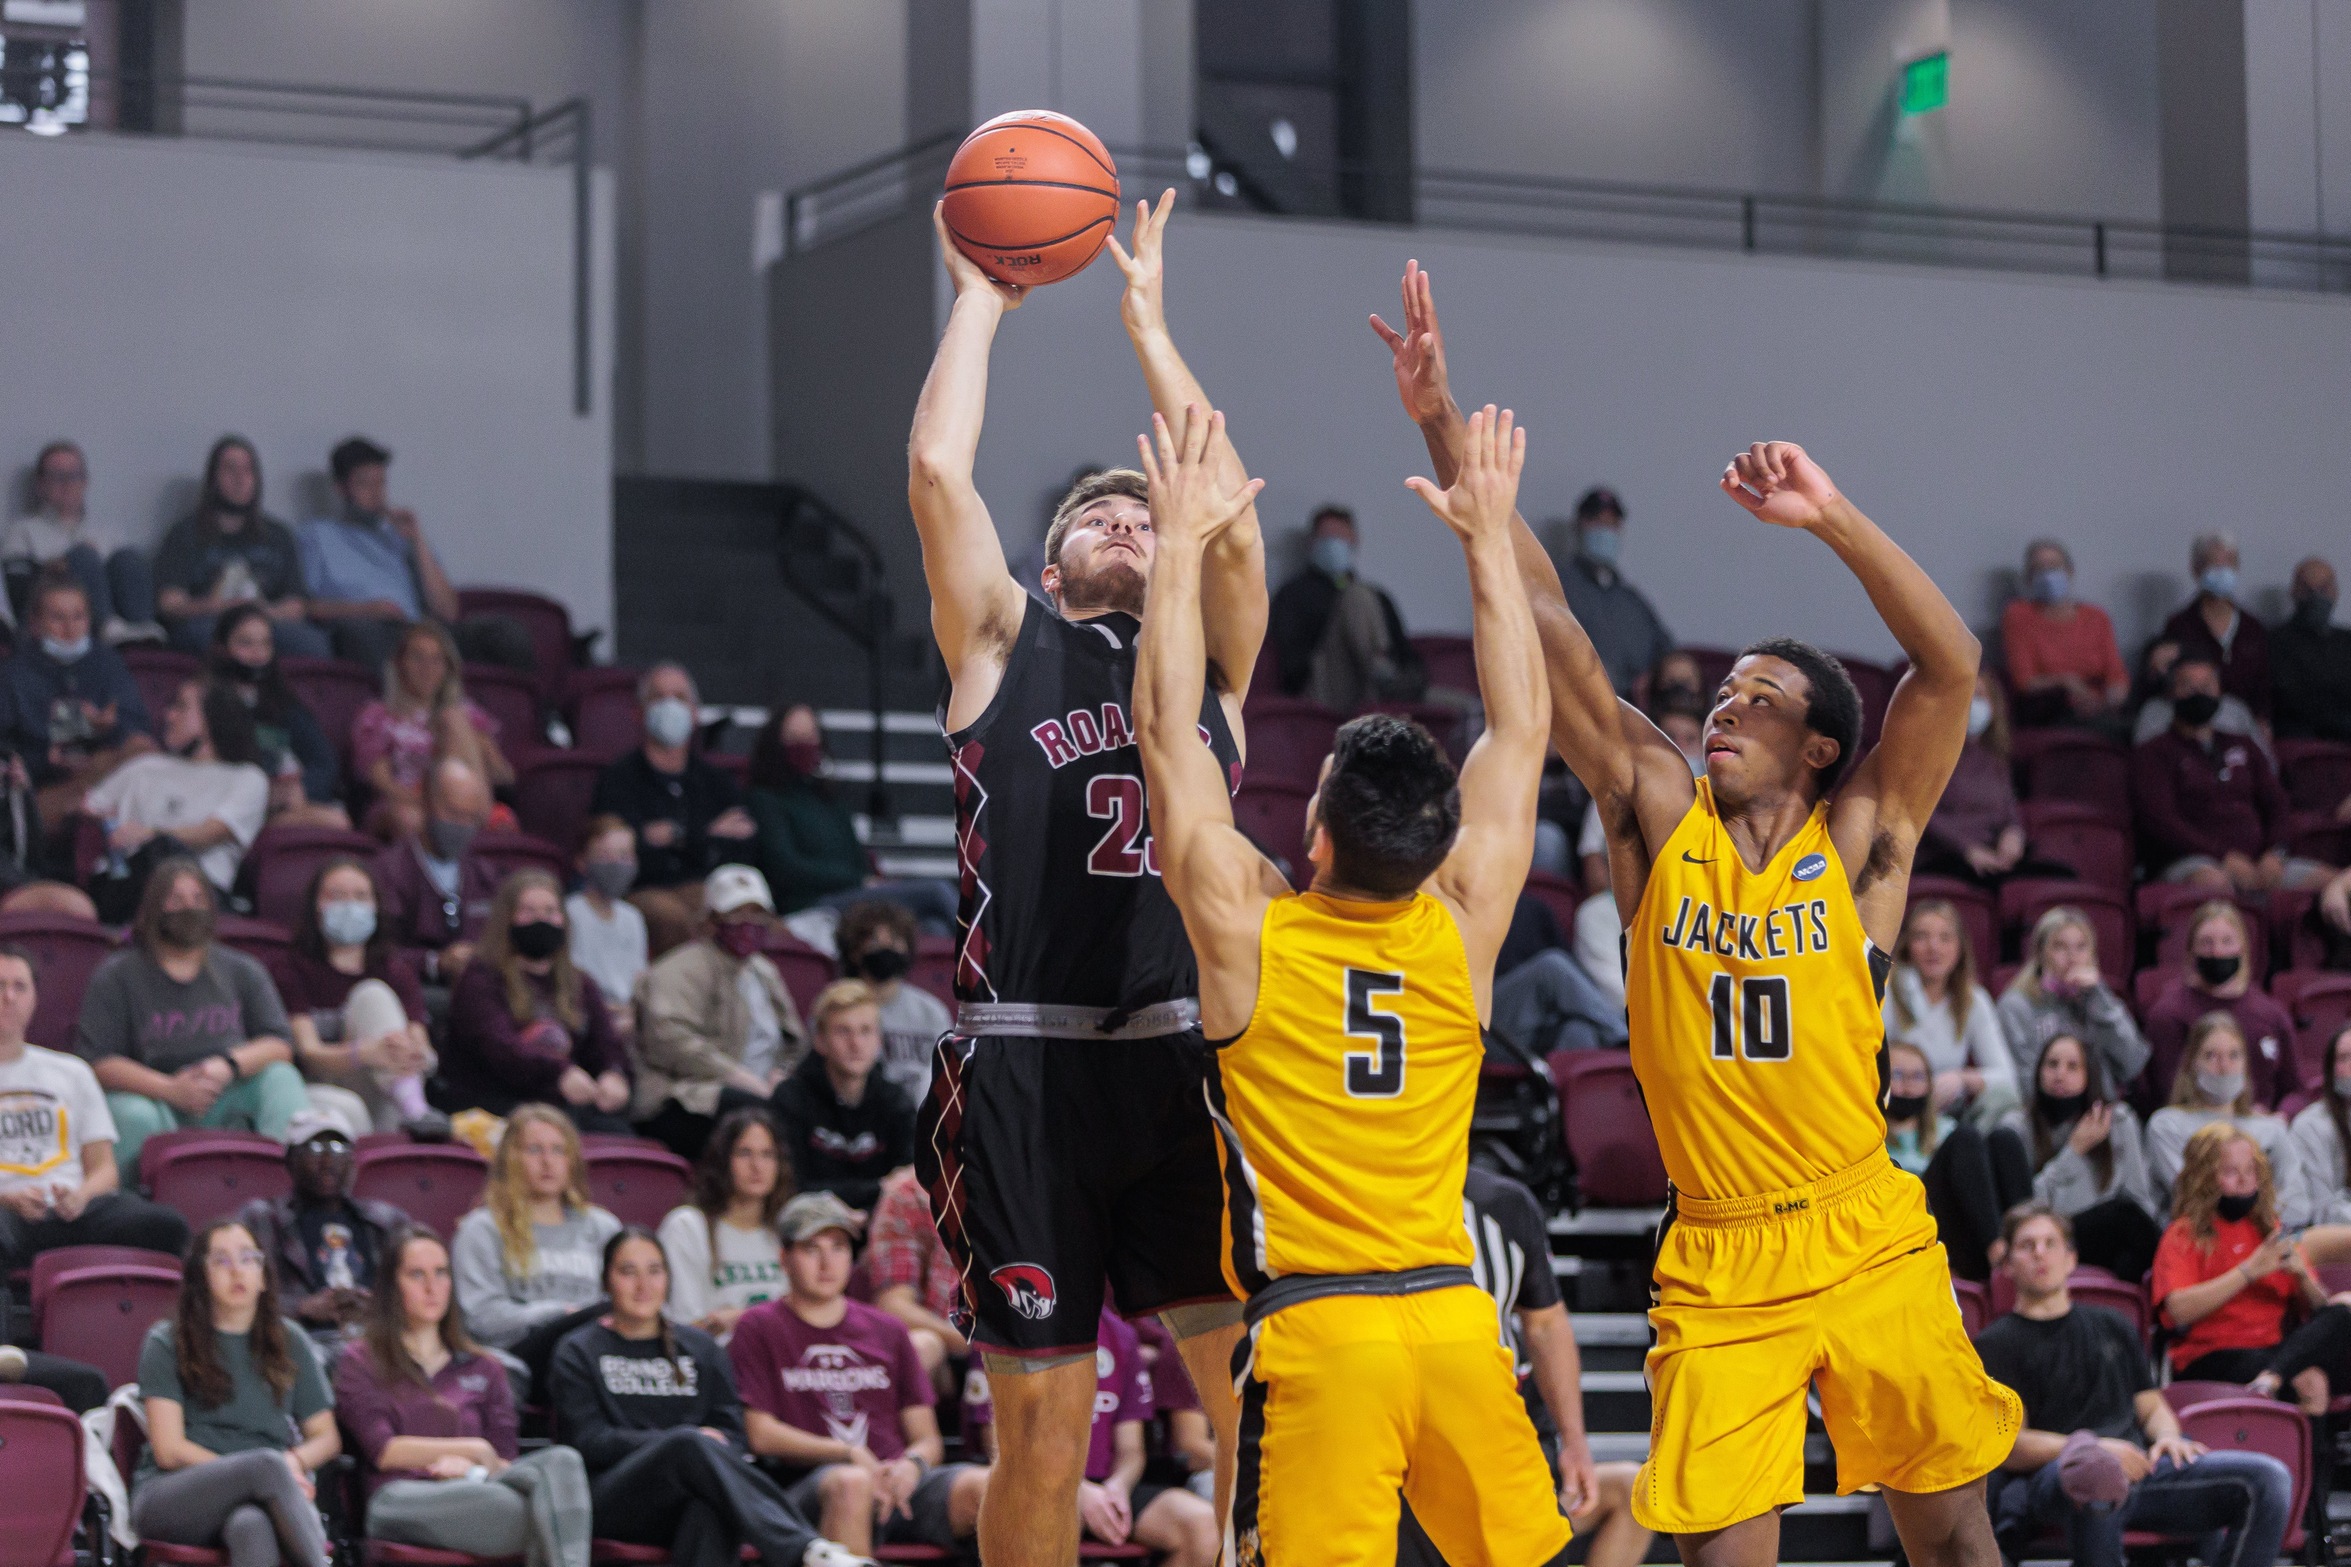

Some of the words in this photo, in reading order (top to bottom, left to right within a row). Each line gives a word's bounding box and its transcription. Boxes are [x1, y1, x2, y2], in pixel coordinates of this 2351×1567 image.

[993, 253, 1041, 267] ROCK
[1797, 860, 1826, 877] NCAA
[1662, 896, 1828, 962] JACKETS
[1343, 966, 1406, 1099] 5
[1707, 971, 1792, 1062] 10
[1774, 1198, 1808, 1214] R-MC
